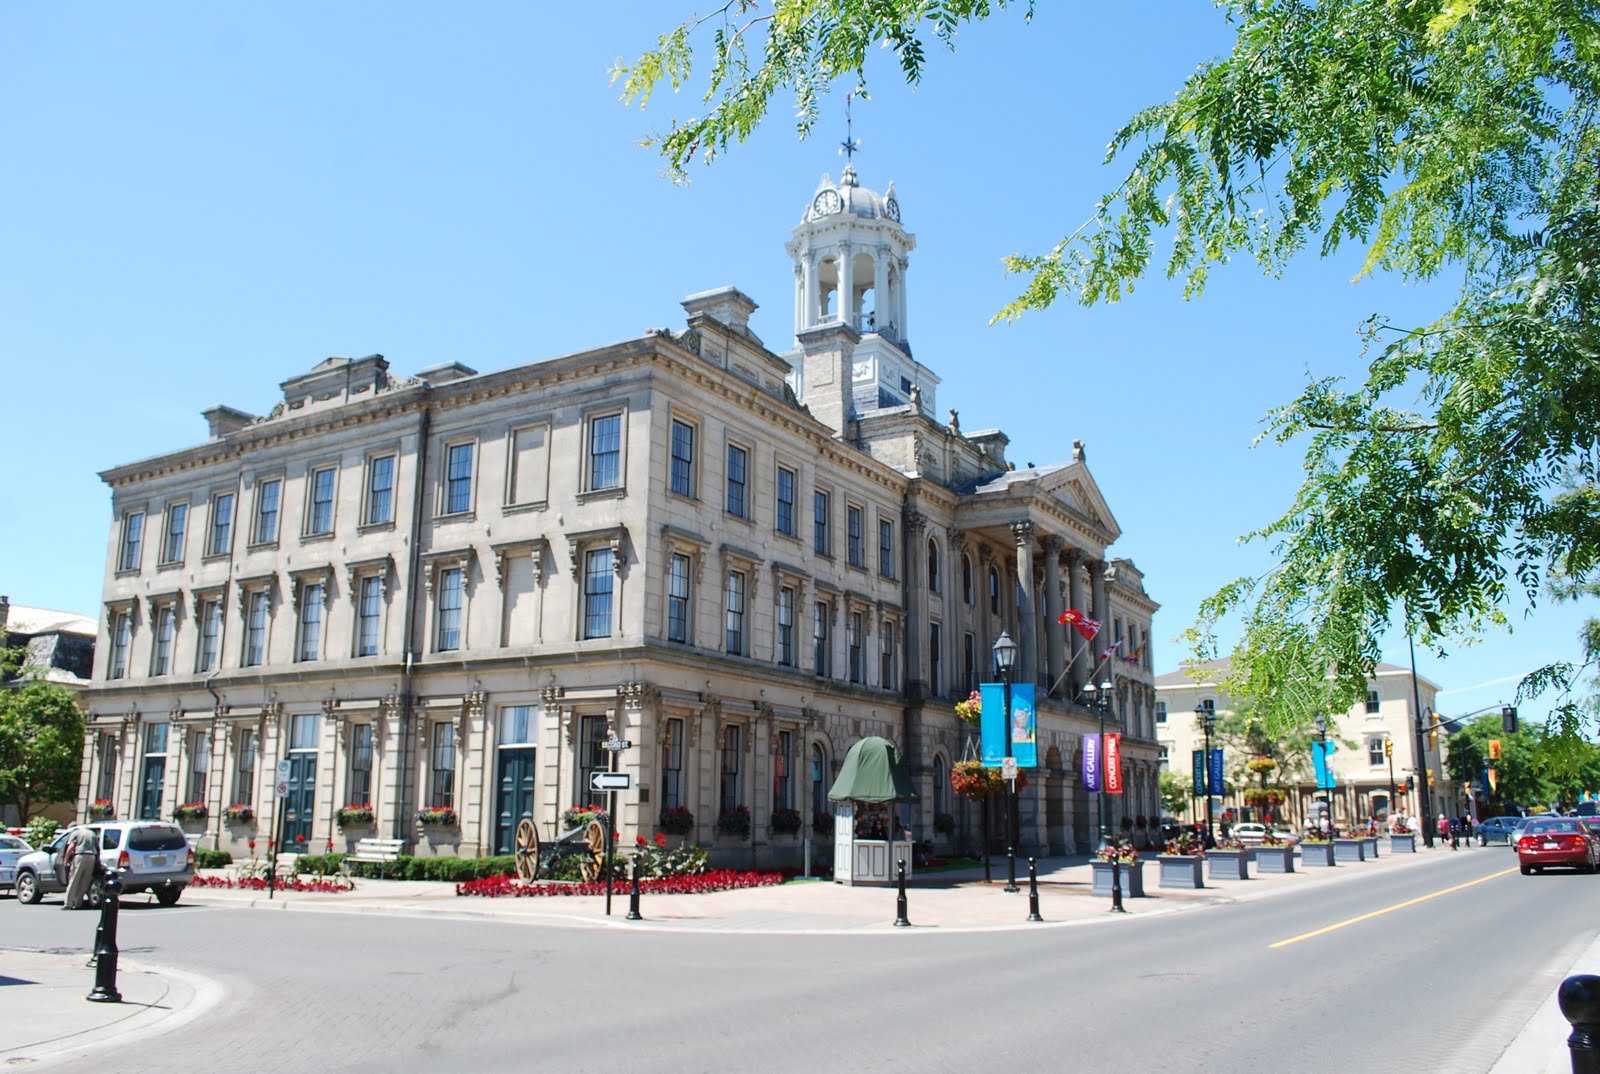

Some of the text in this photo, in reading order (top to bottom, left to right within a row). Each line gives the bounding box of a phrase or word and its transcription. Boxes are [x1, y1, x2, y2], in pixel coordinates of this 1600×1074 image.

[1086, 738, 1095, 789] ART GALLERY
[1107, 738, 1117, 790] CONCERT HALL
[1195, 768, 1203, 794] CONCERT
[1213, 752, 1222, 793] ART GALLERY
